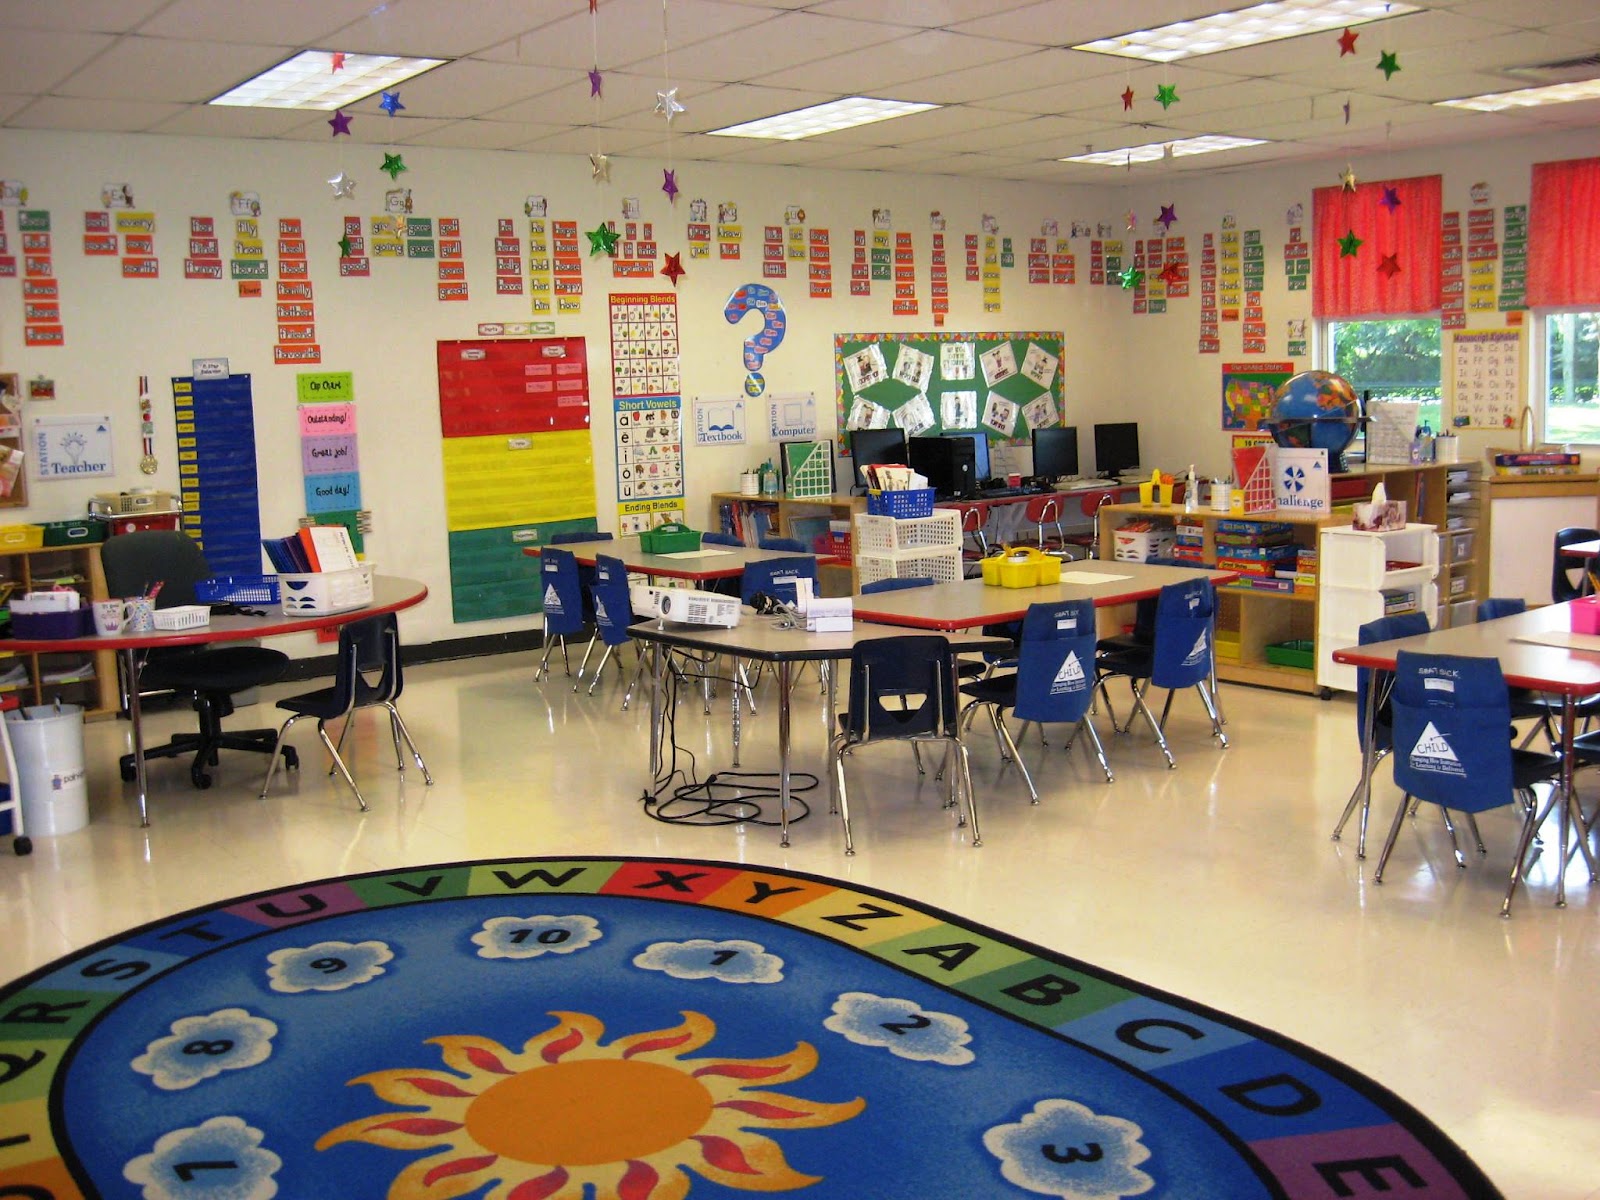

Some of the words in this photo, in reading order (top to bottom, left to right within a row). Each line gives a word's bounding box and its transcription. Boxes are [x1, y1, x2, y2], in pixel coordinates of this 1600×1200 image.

[119, 219, 153, 232] every
[346, 223, 359, 235] go
[236, 243, 262, 256] from
[374, 243, 404, 256] going
[441, 242, 461, 256] girl
[497, 240, 519, 252] here
[187, 262, 222, 278] funny
[232, 262, 267, 276] found
[341, 259, 369, 275] good
[498, 258, 521, 274] help
[531, 259, 548, 271] had
[555, 260, 580, 271] house
[279, 284, 312, 299] family
[439, 283, 468, 299] great
[499, 279, 522, 290] have
[555, 279, 582, 294] happy
[560, 298, 580, 310] how
[610, 295, 649, 304] Beginning
[651, 295, 675, 303] Blends
[278, 305, 313, 318] father
[280, 327, 314, 341] friend
[1454, 334, 1489, 344] Manuscript
[1490, 332, 1518, 342] Alphabet
[276, 347, 320, 360] favorite
[619, 401, 644, 410] Short
[646, 400, 677, 408] Vowels
[307, 413, 347, 425] Outstanding!
[702, 431, 742, 442] Textbook
[772, 427, 815, 437] Computer
[40, 432, 49, 476] STATION
[312, 447, 332, 458] Great
[335, 446, 348, 459] job!
[51, 460, 106, 474] Teacher
[316, 486, 333, 497] Good
[335, 484, 350, 496] day!
[625, 503, 651, 513] Ending
[652, 501, 677, 510] Blends
[1277, 494, 1323, 507] hallenge
[1417, 742, 1449, 755] CHILD
[491, 867, 587, 888] W
[633, 869, 709, 893] X
[388, 874, 442, 896] V
[744, 880, 805, 904] Y
[256, 892, 328, 919] U
[820, 902, 902, 931] Z
[159, 919, 224, 944] T
[508, 927, 571, 944] 10
[708, 949, 740, 966] 1
[901, 940, 982, 971] A
[80, 958, 151, 981] S
[999, 973, 1082, 1007] B
[880, 1013, 932, 1036] 2
[1114, 1018, 1207, 1055] C
[1218, 1073, 1322, 1117] D
[1313, 1153, 1429, 1198] E
